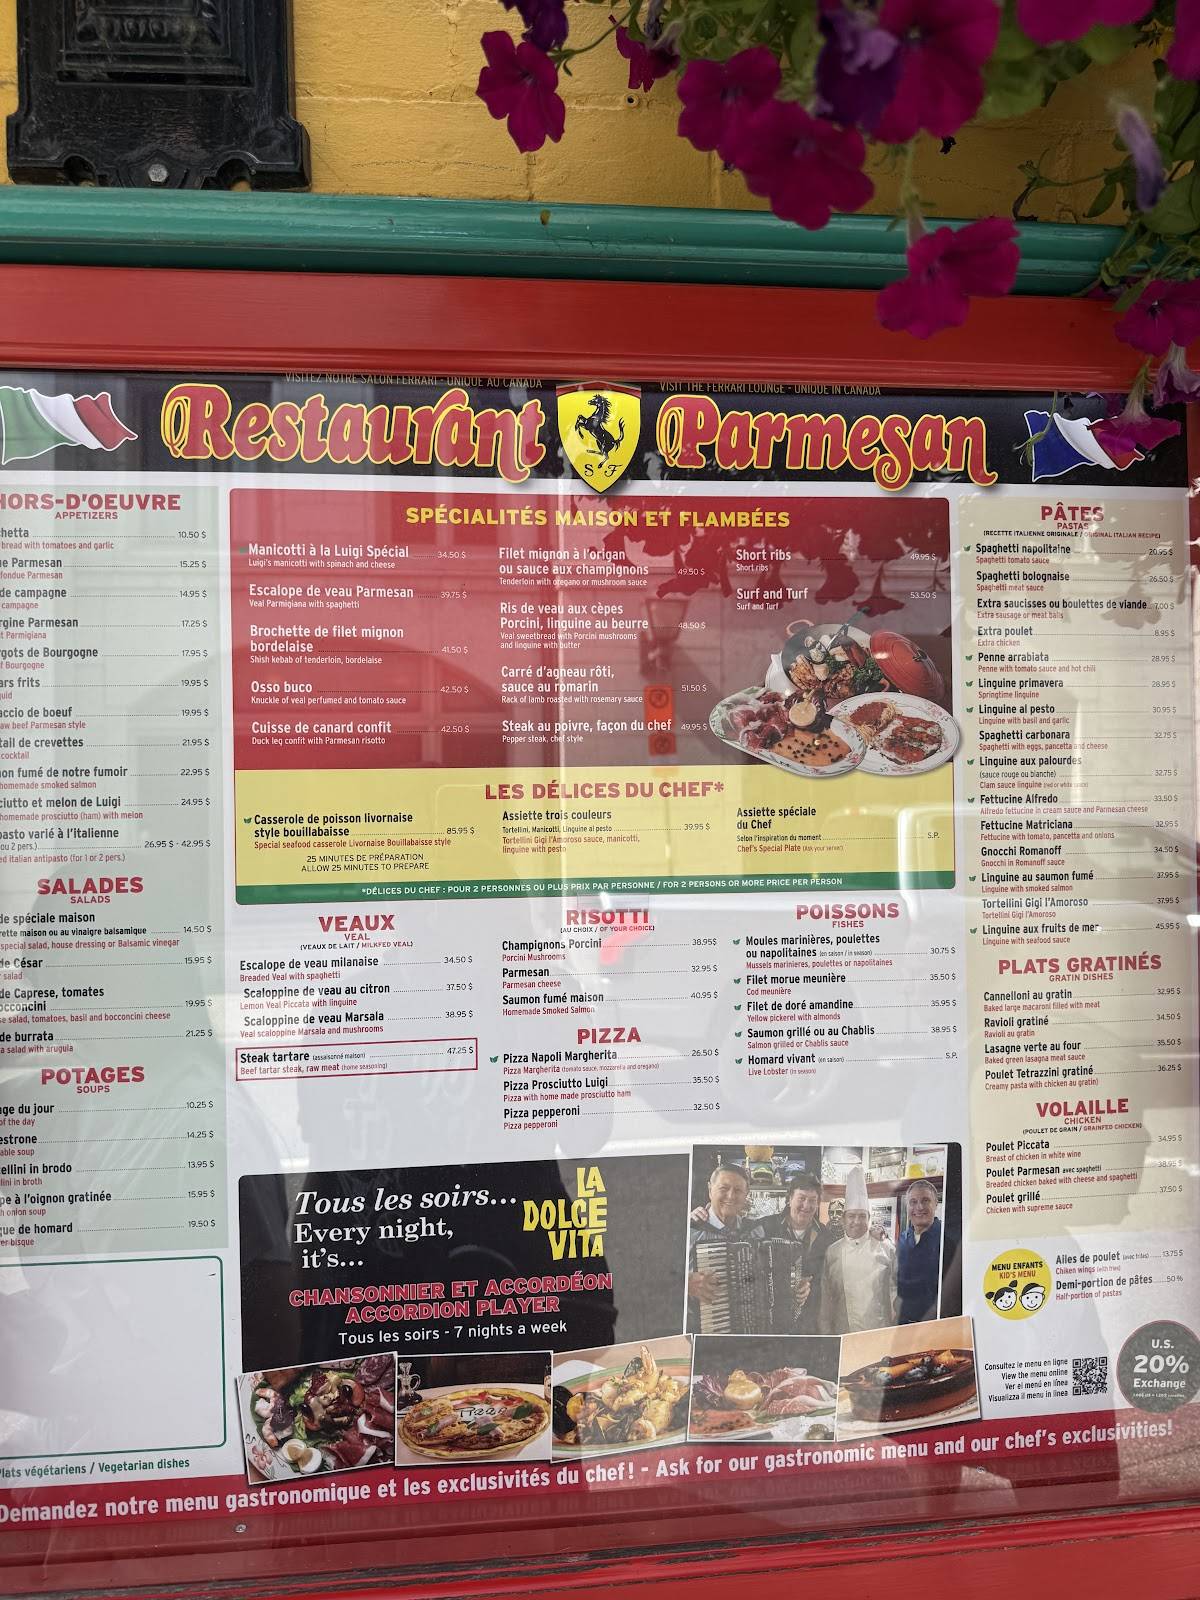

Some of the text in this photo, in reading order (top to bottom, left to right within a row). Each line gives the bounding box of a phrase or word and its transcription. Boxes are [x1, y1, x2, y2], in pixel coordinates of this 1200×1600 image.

[326, 374, 358, 384] NOTRE
[361, 374, 395, 385] SALON
[398, 375, 437, 386] FERRARI
[447, 376, 484, 387] UNIQUE
[487, 378, 500, 388] AU
[502, 378, 543, 389] CANADA
[660, 381, 881, 396] VISIT THE FERRARI LOUNGE UNIQUE IN CANADA
[161, 383, 998, 491] Restaurant Parmesan
[54, 511, 118, 520] APPETIZERS
[406, 503, 790, 528] SPÉCIALITÉS MAISON ET FLAMBÉES
[1041, 501, 1104, 522] PÂTES
[1057, 522, 1089, 530] PASTAS
[178, 530, 207, 539] 10.50 $
[1, 541, 22, 549] bread
[24, 541, 41, 549] with
[93, 541, 114, 551] garlic
[248, 543, 409, 559] Manicotti à la Luigi Spécial
[736, 548, 791, 561] Short ribs
[249, 584, 414, 598] Escalope de veau Parmesan
[736, 587, 808, 599] Surf and Turf
[978, 704, 1055, 715] Linguine al pesto
[485, 783, 524, 800] LES
[532, 780, 620, 799] DÉLICES
[625, 782, 653, 798] DU
[254, 813, 413, 825] Casserole de poisson livornaise
[254, 826, 350, 839] style bouillabaisse
[319, 854, 354, 863] MINUTES
[356, 854, 366, 862] DE
[369, 852, 424, 862] PRÉPARATION
[37, 876, 144, 895] SALADES
[70, 896, 111, 904] SALADS
[566, 908, 649, 926] RISOTTI
[796, 903, 899, 920] POISSONS
[318, 914, 395, 933] VEAUX
[832, 920, 864, 928] FISHES
[344, 933, 370, 941] VEAL
[240, 956, 379, 972] Escalope de veau milanaise
[998, 951, 1161, 975] PLATS GRATINÉS
[1049, 972, 1113, 982] GRATIN DISHES
[502, 993, 604, 1005] Saumon fumé maison
[577, 1027, 641, 1045] PIZZA
[240, 1051, 310, 1063] Steak tartare
[748, 1054, 815, 1065] Homard vivant
[41, 1066, 145, 1085] POTAGES
[76, 1085, 110, 1093] SOUPS
[503, 1077, 608, 1091] Pizza Prosciutto Luigi
[1036, 1098, 1129, 1118] VOLAILLE
[1064, 1116, 1101, 1124] CHICKEN
[577, 1166, 606, 1198] LA
[296, 1184, 516, 1216] Tous les soirs...
[986, 1191, 1040, 1204] Poulet grillé
[523, 1197, 607, 1232] DOLCE
[294, 1216, 454, 1244] Every night,
[548, 1228, 607, 1260] VITA
[301, 1249, 363, 1269] it's...
[991, 1261, 1043, 1271] MENU ENFANTS
[999, 1270, 1036, 1279] KID'S MENU
[288, 1271, 613, 1307] CHANSONNIER ET ACCORDÉON
[345, 1295, 560, 1324] ACCORDION PLAYER
[339, 1319, 567, 1345] Tous les soirs 7 nights a week
[1151, 1339, 1174, 1349] U.S.
[1133, 1354, 1189, 1374] 20%
[1001, 1368, 1068, 1380] View the menu online
[1133, 1378, 1186, 1390] Exchange
[0, 1457, 190, 1481] lats végétariens Vegetarian dishes
[0, 1504, 98, 1525] Demandez
[105, 1498, 159, 1518] notre
[165, 1496, 220, 1514] menu
[225, 1483, 371, 1512] gastronomique
[377, 1478, 396, 1497] et
[403, 1477, 431, 1496] les
[437, 1467, 550, 1494] exclusivités
[556, 1465, 580, 1486] du
[656, 1456, 690, 1478] Ask
[696, 1454, 721, 1475] for
[727, 1453, 760, 1473] our
[764, 1441, 876, 1471] gastronomic
[881, 1439, 928, 1460] menu
[934, 1434, 965, 1456] and
[970, 1433, 999, 1453] our
[1005, 1427, 1056, 1450] chef's
[1063, 1419, 1174, 1445] exclusivities!
